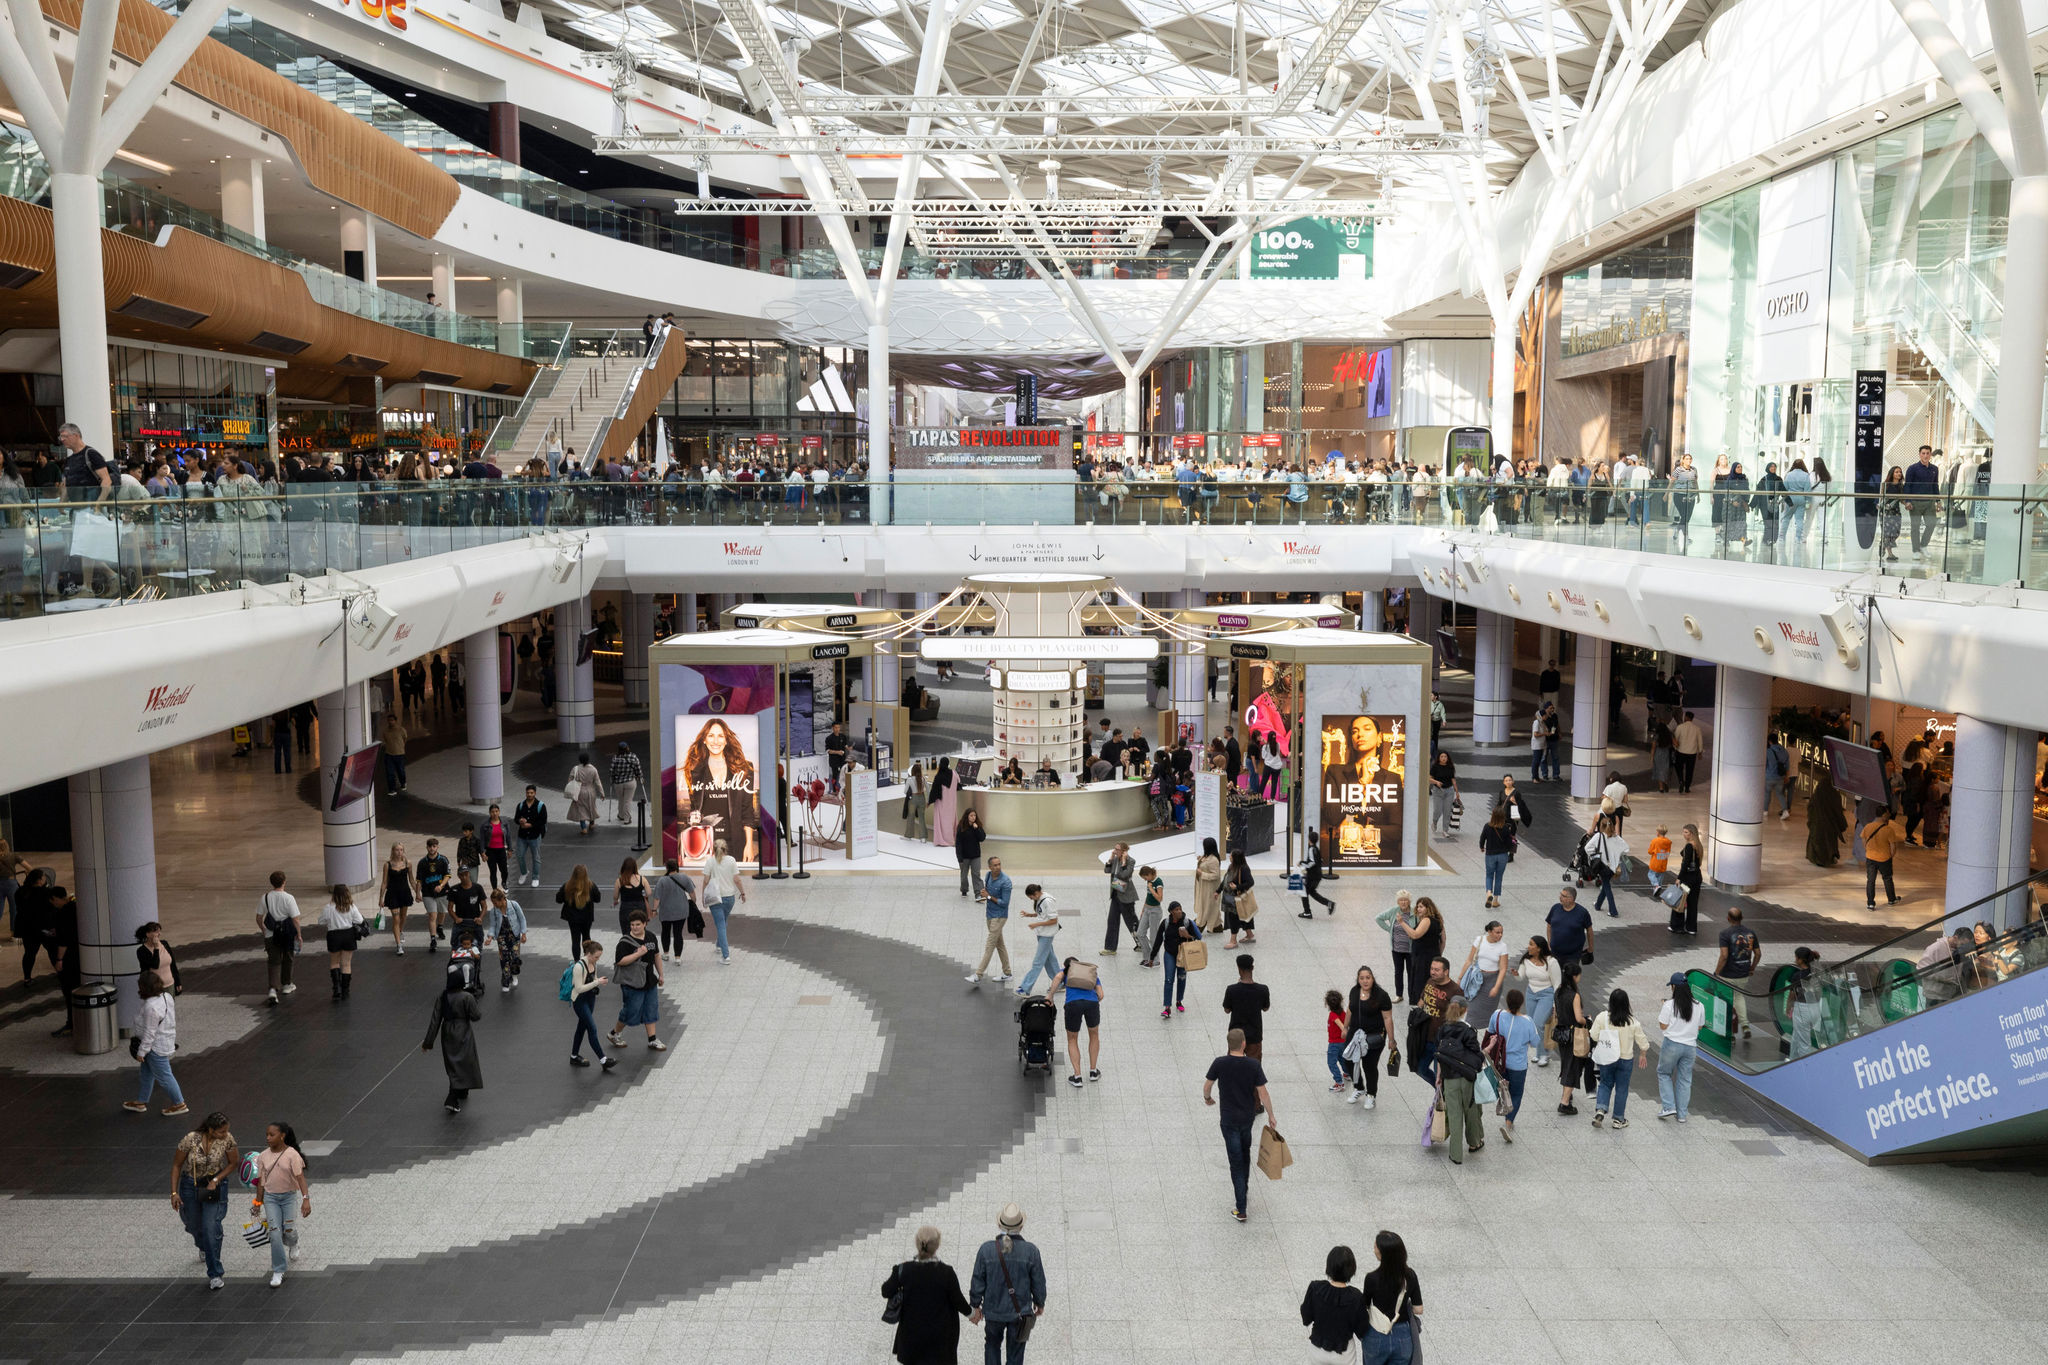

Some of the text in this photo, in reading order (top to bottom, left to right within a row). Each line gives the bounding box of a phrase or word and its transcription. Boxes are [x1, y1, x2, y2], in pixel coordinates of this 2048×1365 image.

[1259, 231, 1314, 249] 100%
[1768, 290, 1809, 320] OYSHO
[1568, 315, 1625, 355] Abercrombie
[1640, 298, 1668, 338] Fitch
[1332, 351, 1378, 383] H&M
[1868, 376, 1884, 384] Lobby
[1859, 383, 1869, 397] 2
[1861, 405, 1880, 415] P A
[927, 455, 1042, 463] SPANISH BAR AND RESTAURANT
[723, 542, 763, 556] Westfield
[1283, 541, 1321, 555] Westfield
[1560, 588, 1587, 606] Westfield
[736, 618, 756, 628] ARMANI
[830, 616, 853, 626] ARMANI
[1219, 616, 1247, 625] VALENTINO
[1319, 618, 1340, 627] VALENTINO
[1777, 622, 1820, 647] Westfield
[815, 646, 847, 657] LANCÔME
[963, 644, 1120, 653] THE BEAUTY PLAYGROUND
[1792, 649, 1812, 659] LONDON
[1011, 673, 1067, 681] CREATE YOUR
[142, 684, 196, 713] Westfield
[137, 717, 164, 732] LONDON
[720, 770, 758, 795] belle
[1326, 783, 1399, 804] LIBRE
[1998, 1012, 2024, 1031] From
[2022, 1005, 2046, 1023] floor
[2005, 1029, 2025, 1050] find
[2024, 1027, 2041, 1044] the
[1853, 1040, 1931, 1089] Find the
[2010, 1050, 2035, 1069] Shop
[1866, 1072, 1999, 1139] perfect piece.
